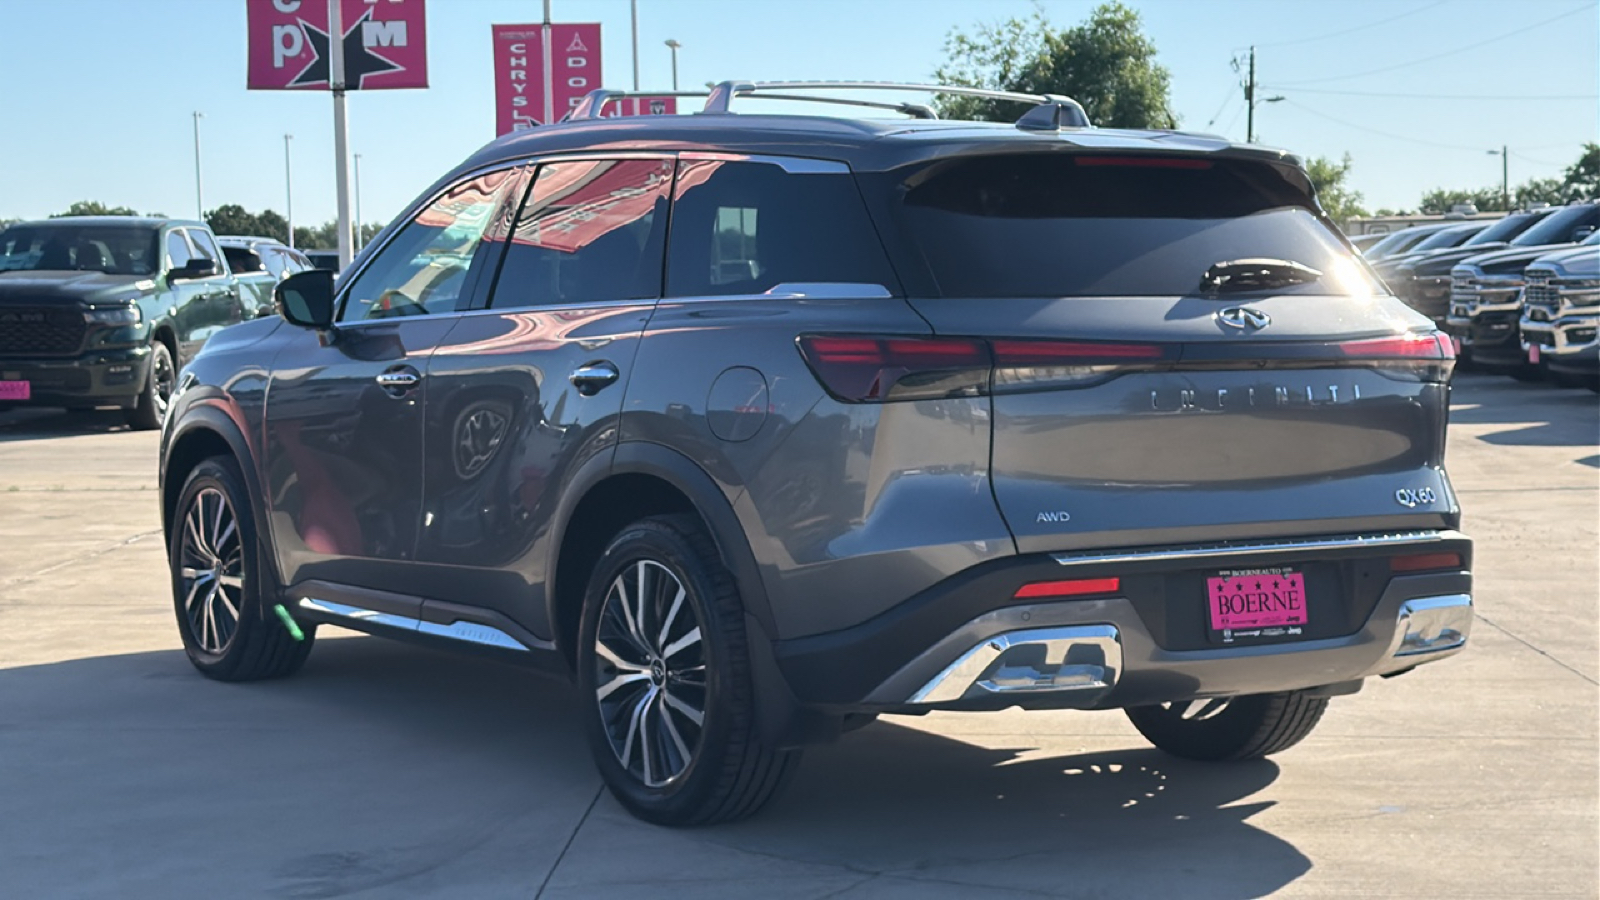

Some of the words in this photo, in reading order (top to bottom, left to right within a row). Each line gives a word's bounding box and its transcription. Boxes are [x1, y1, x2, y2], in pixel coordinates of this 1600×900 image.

[362, 0, 408, 47] M
[1151, 385, 1361, 409] INFINITI
[1395, 487, 1436, 507] QX60
[1036, 511, 1071, 523] AWD
[1218, 590, 1301, 615] BOERNE
